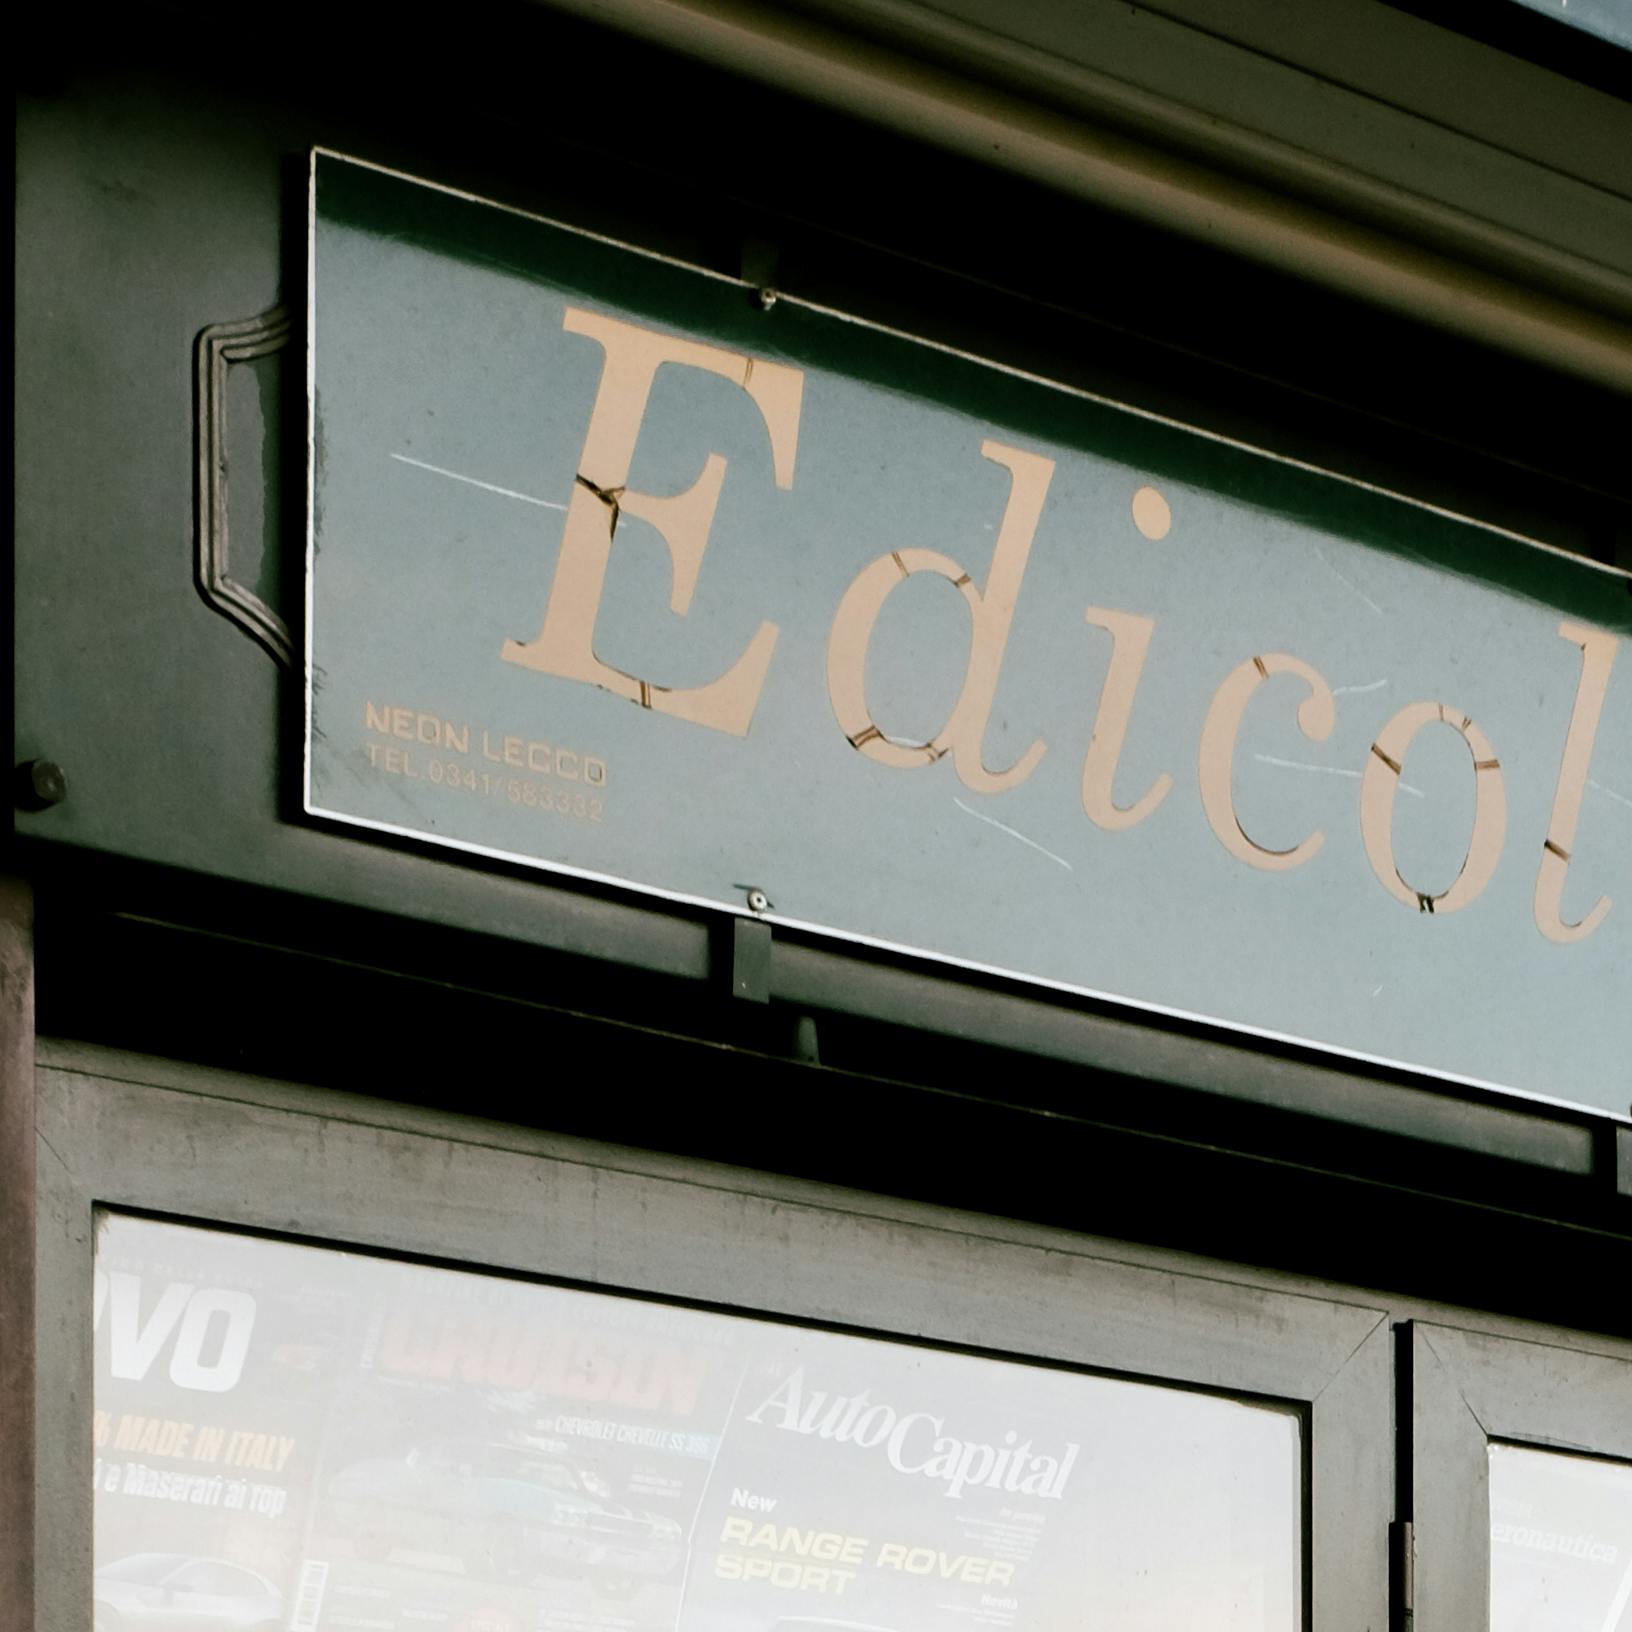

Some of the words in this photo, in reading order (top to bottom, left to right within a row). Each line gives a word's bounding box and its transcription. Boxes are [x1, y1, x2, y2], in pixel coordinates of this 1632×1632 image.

[365, 700, 470, 753] NEON
[482, 729, 607, 787] LECCO
[113, 1413, 194, 1458] MADE
[193, 1425, 225, 1463] IN
[224, 1431, 297, 1472] ITALY
[745, 1362, 1081, 1500] AutoCapital
[123, 1462, 222, 1506] Maserati
[730, 1487, 777, 1513] New
[714, 1554, 856, 1596] SPORT
[719, 1515, 869, 1565] RANGE
[876, 1543, 1016, 1588] ROVER
